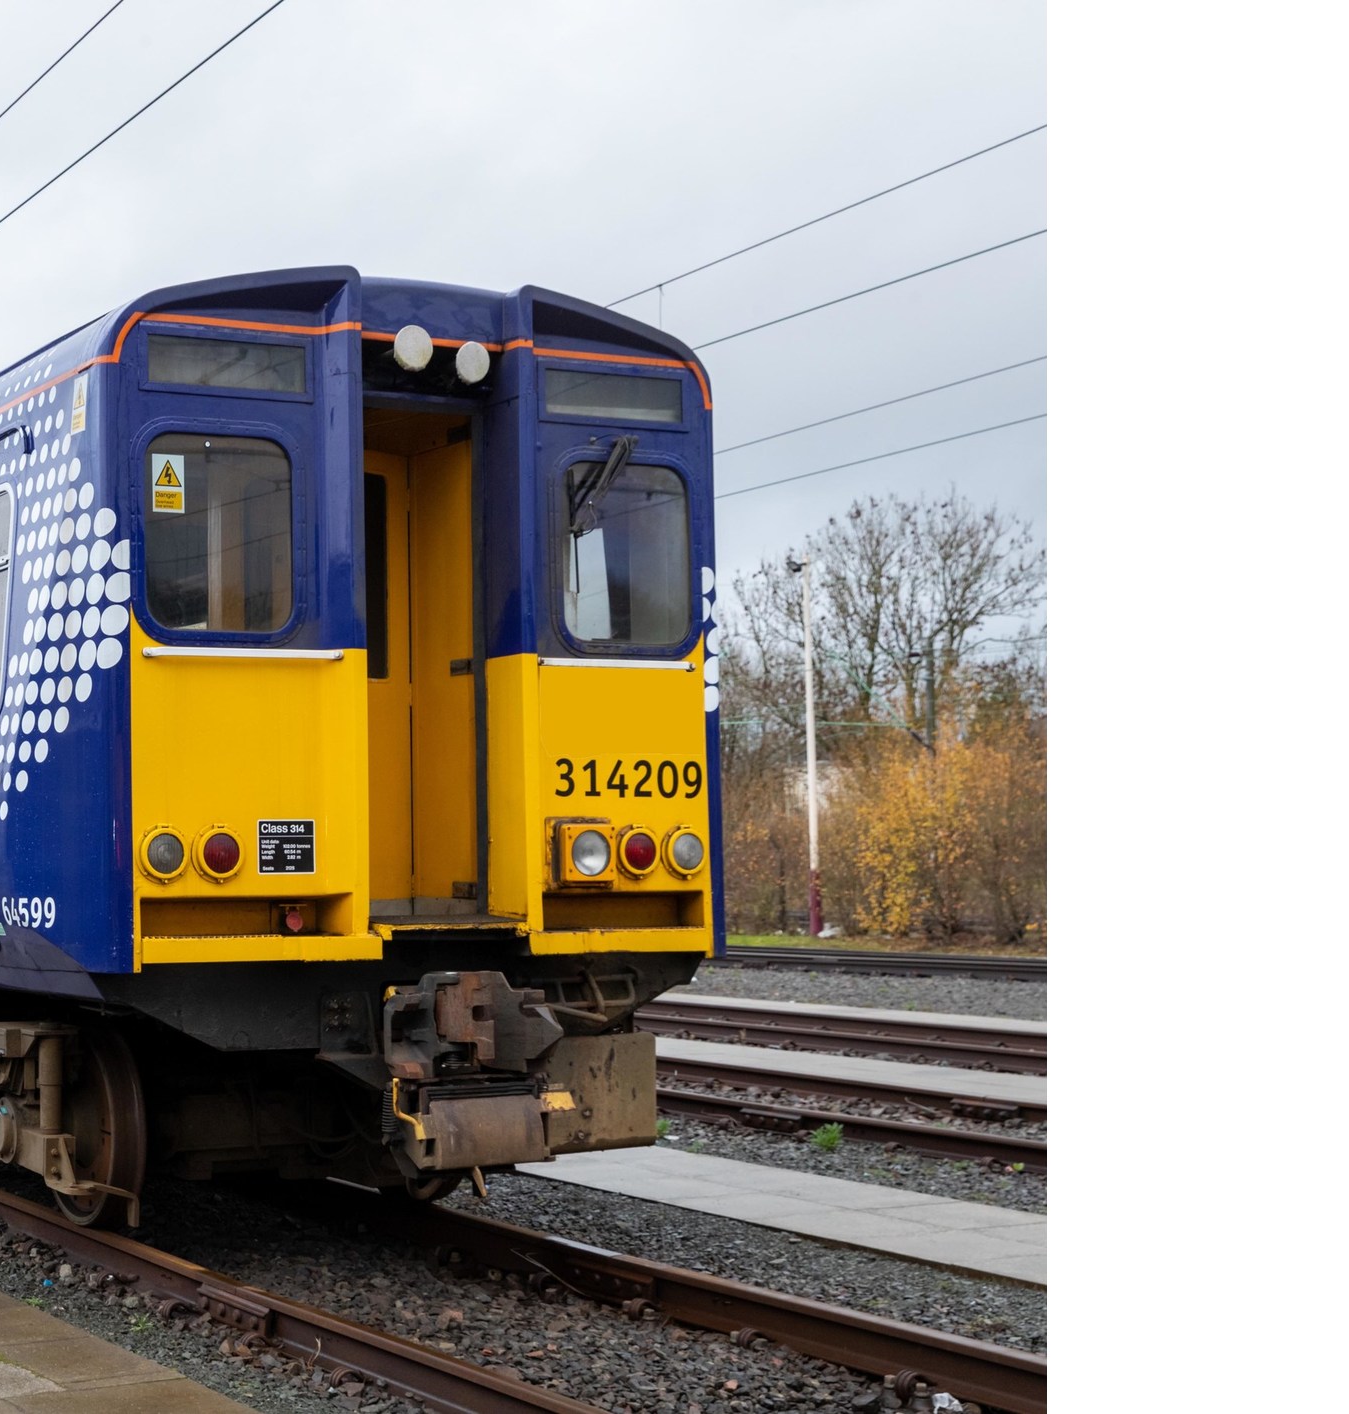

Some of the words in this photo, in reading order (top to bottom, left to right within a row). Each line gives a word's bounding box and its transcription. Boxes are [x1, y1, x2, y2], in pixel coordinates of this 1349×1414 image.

[155, 491, 177, 499] Danger
[555, 758, 703, 799] 314209
[261, 823, 288, 833] Class
[290, 824, 305, 833] 314
[1, 896, 56, 929] 64599
